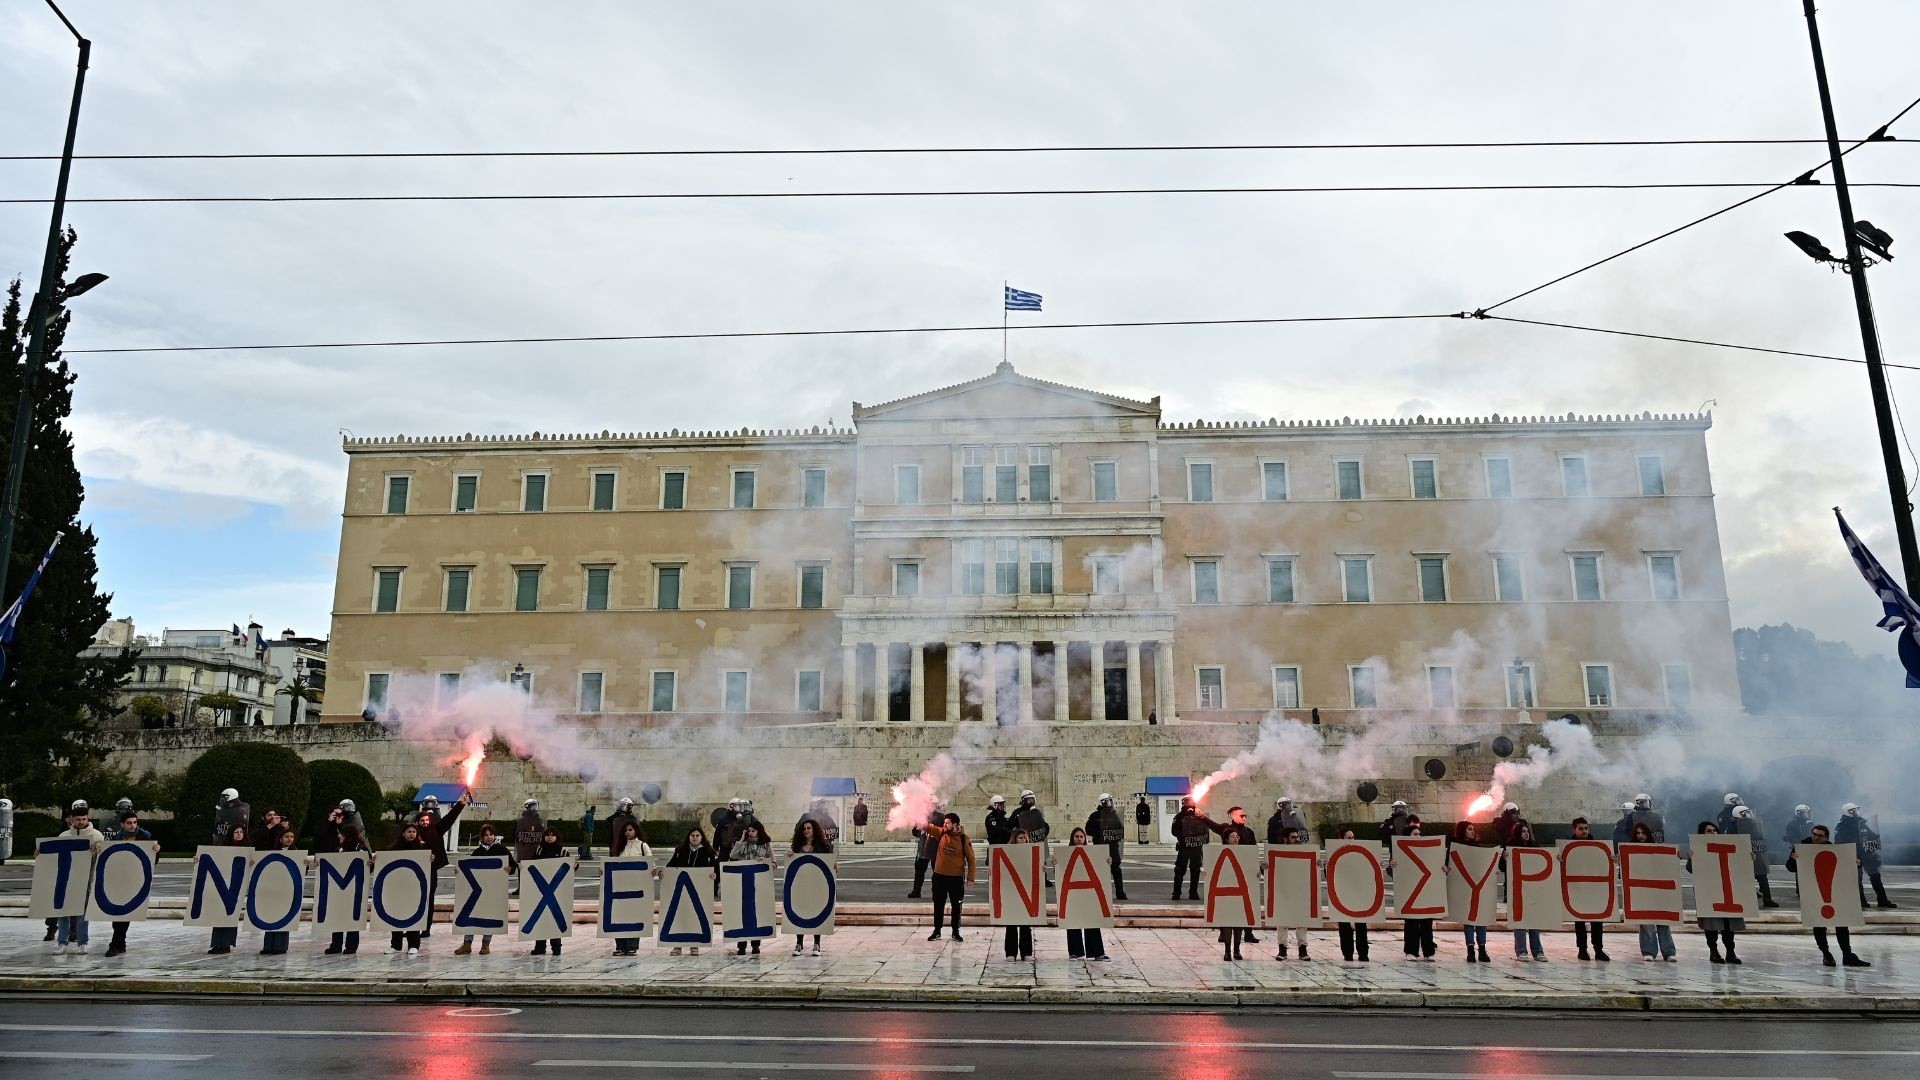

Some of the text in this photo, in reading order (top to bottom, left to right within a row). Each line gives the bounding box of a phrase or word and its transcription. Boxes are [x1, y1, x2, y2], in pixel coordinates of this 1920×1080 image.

[40, 839, 153, 916] ΤΟ
[190, 853, 836, 944] ΝΟΜΟΣΧΕΔΙΟ
[992, 846, 1111, 918] ΝΑ
